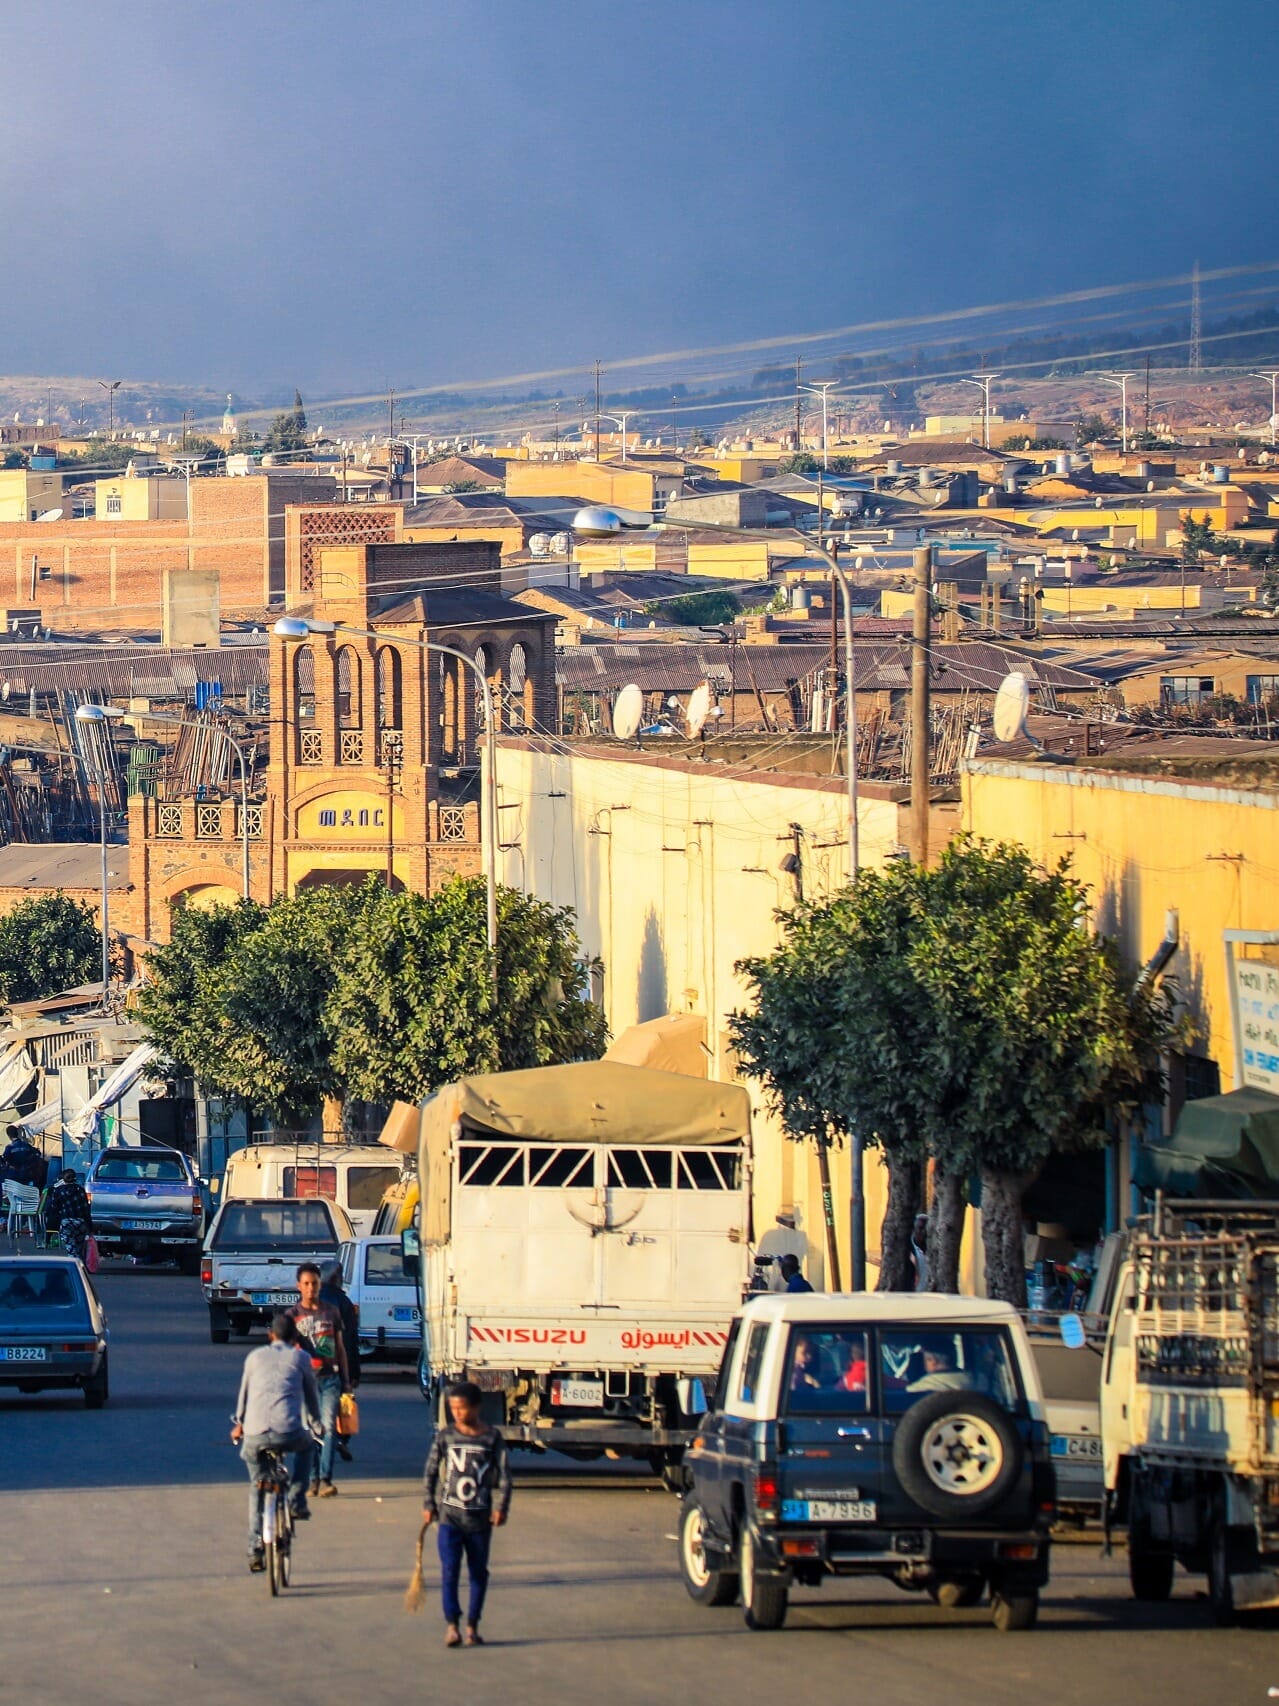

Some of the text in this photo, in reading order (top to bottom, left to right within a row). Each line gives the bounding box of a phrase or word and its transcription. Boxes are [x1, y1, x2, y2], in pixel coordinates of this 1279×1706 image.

[507, 1328, 586, 1344] ISUZU
[621, 1328, 689, 1348] ايسوزو
[7, 1348, 44, 1360] B8224
